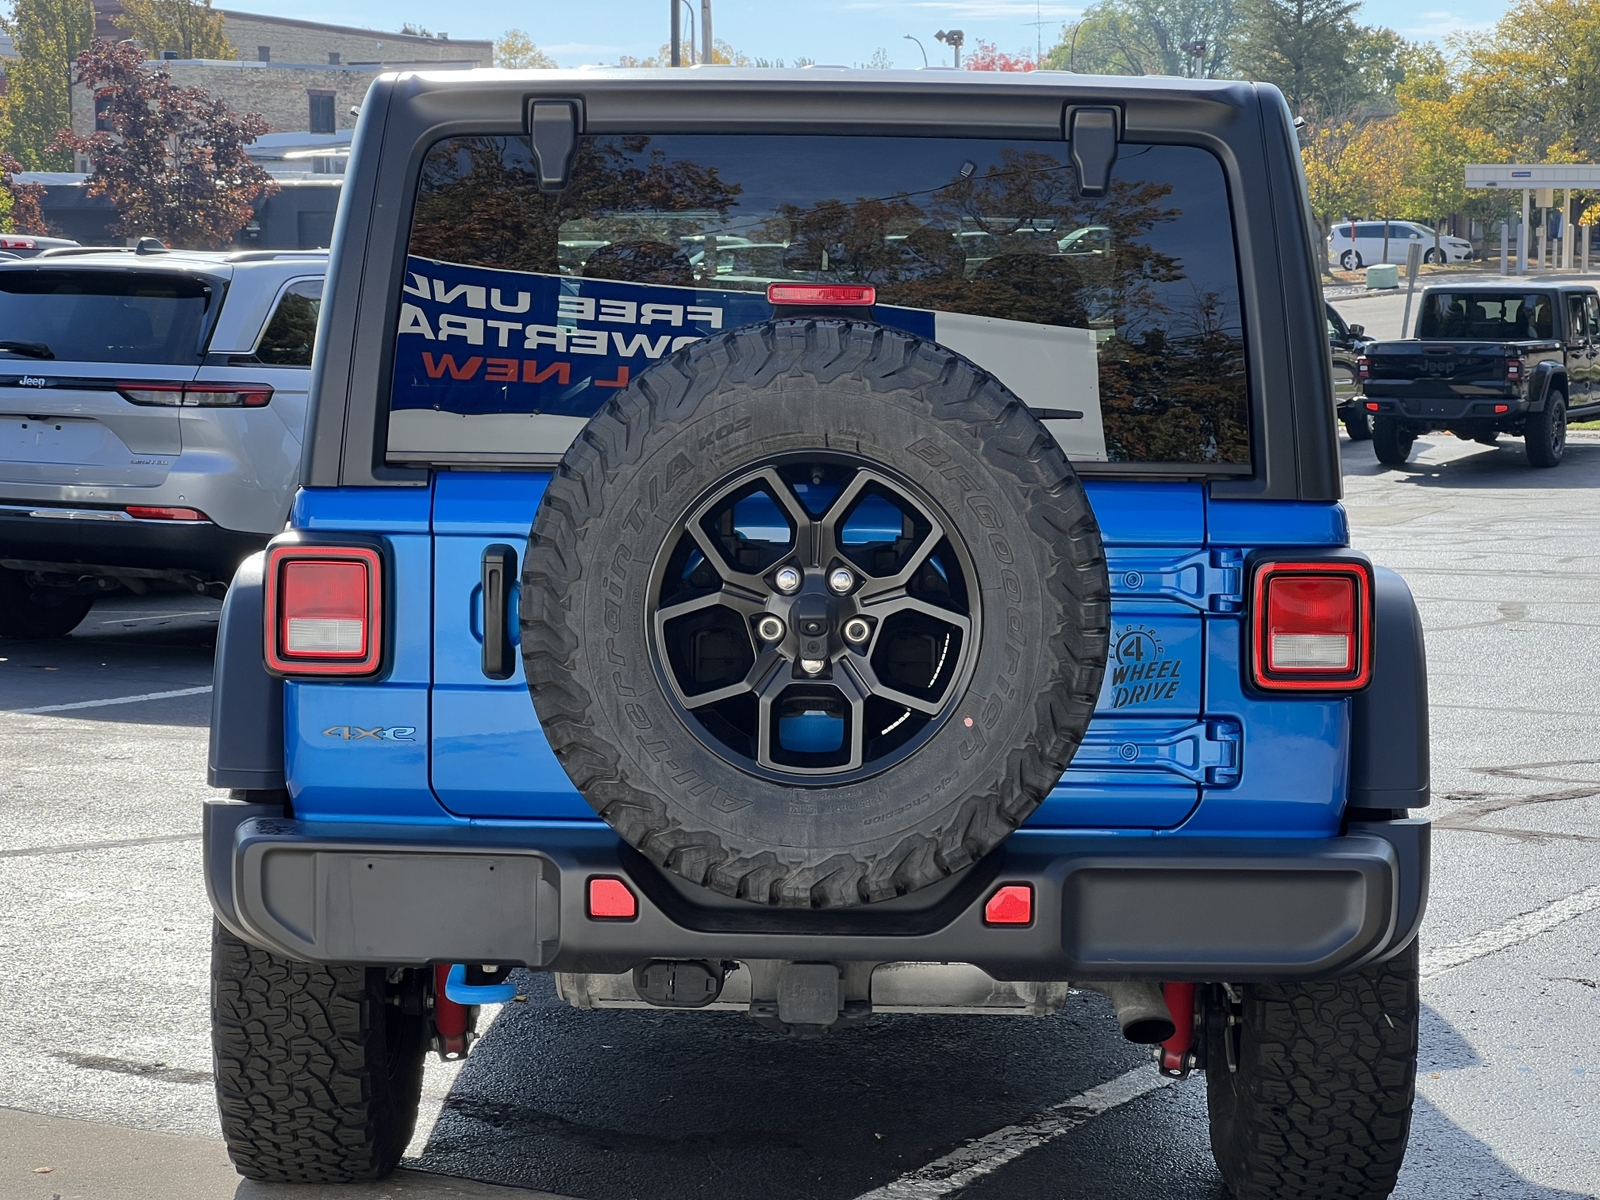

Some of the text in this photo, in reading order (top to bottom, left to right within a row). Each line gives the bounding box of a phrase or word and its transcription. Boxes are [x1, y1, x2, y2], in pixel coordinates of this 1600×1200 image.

[1420, 359, 1455, 374] Jeep
[19, 375, 46, 389] Jeep
[699, 416, 752, 450] KO2
[1109, 624, 1165, 660] ELECTRIC
[1122, 636, 1144, 662] 4
[1112, 660, 1182, 687] WHEEL
[1113, 681, 1181, 709] DRIVE
